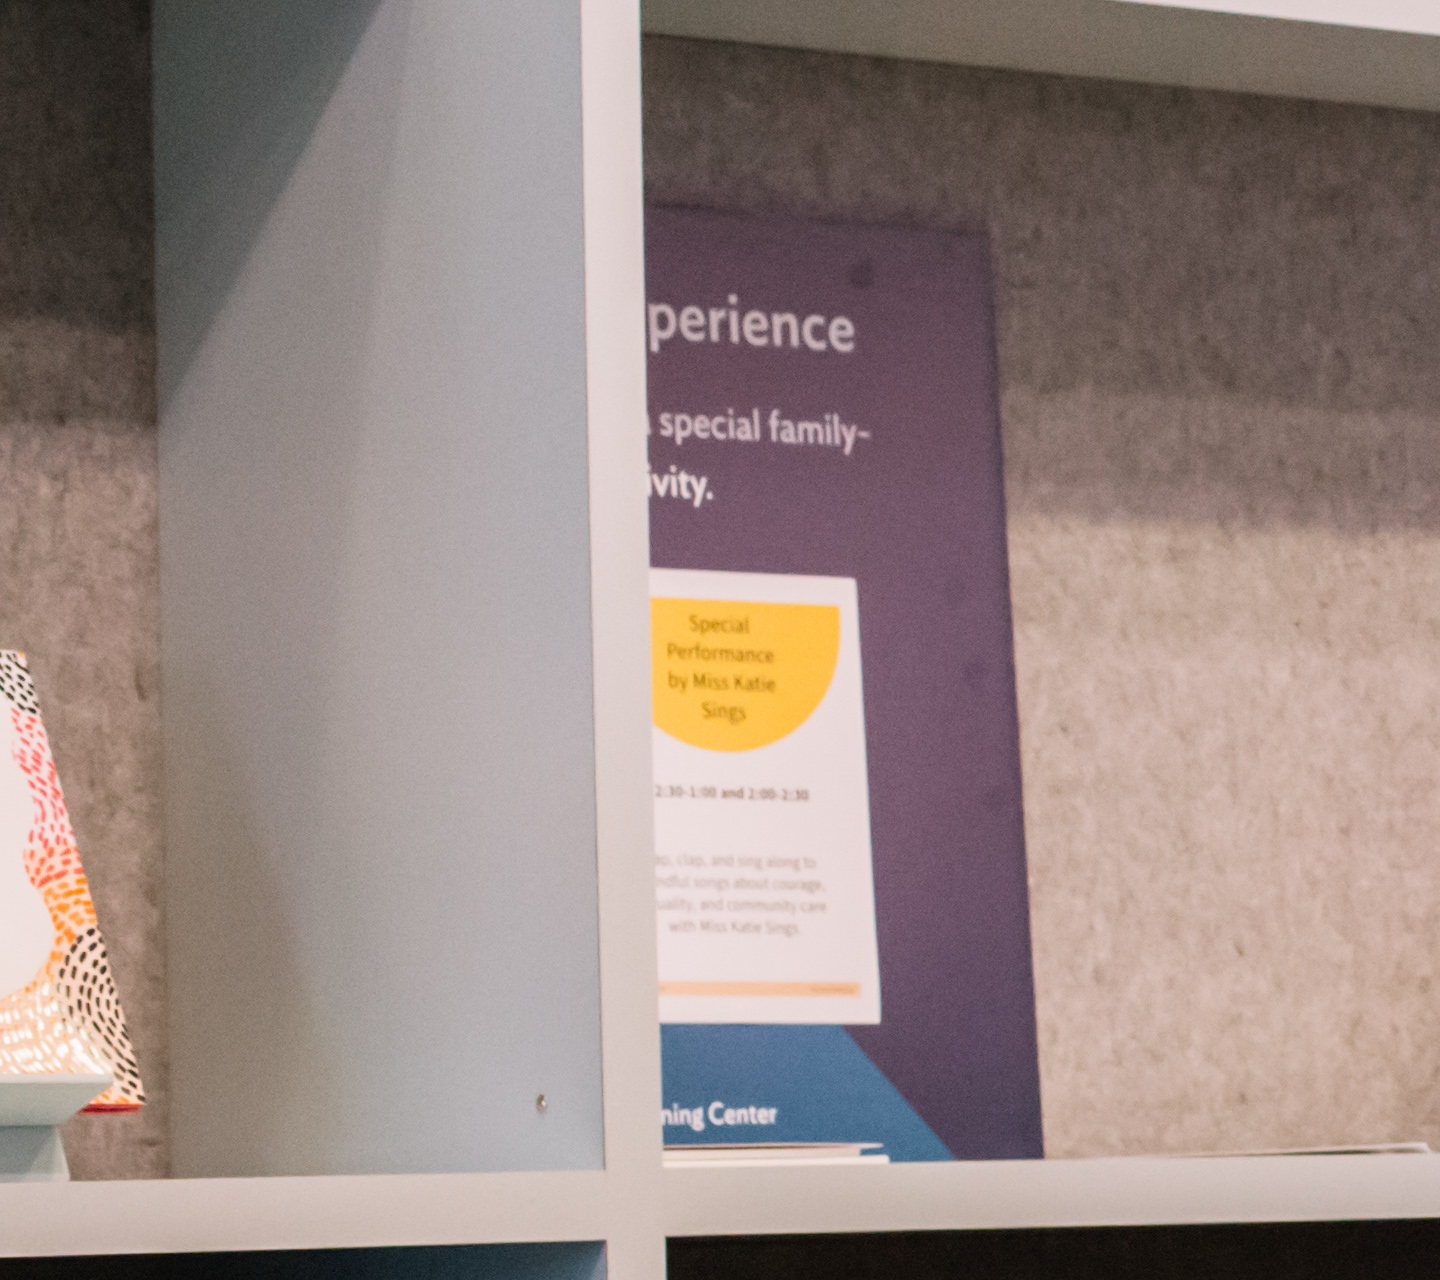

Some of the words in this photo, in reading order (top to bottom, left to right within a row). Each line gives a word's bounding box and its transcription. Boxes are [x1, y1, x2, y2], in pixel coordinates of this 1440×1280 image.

[648, 293, 856, 353] perience
[659, 407, 761, 446] special
[769, 408, 871, 456] family-
[689, 614, 750, 636] Special
[667, 642, 775, 664] Performance
[668, 670, 688, 694] by
[693, 672, 730, 692] Miss
[734, 673, 776, 694] Katie
[701, 700, 747, 726] Sings
[708, 1101, 777, 1127] Center
